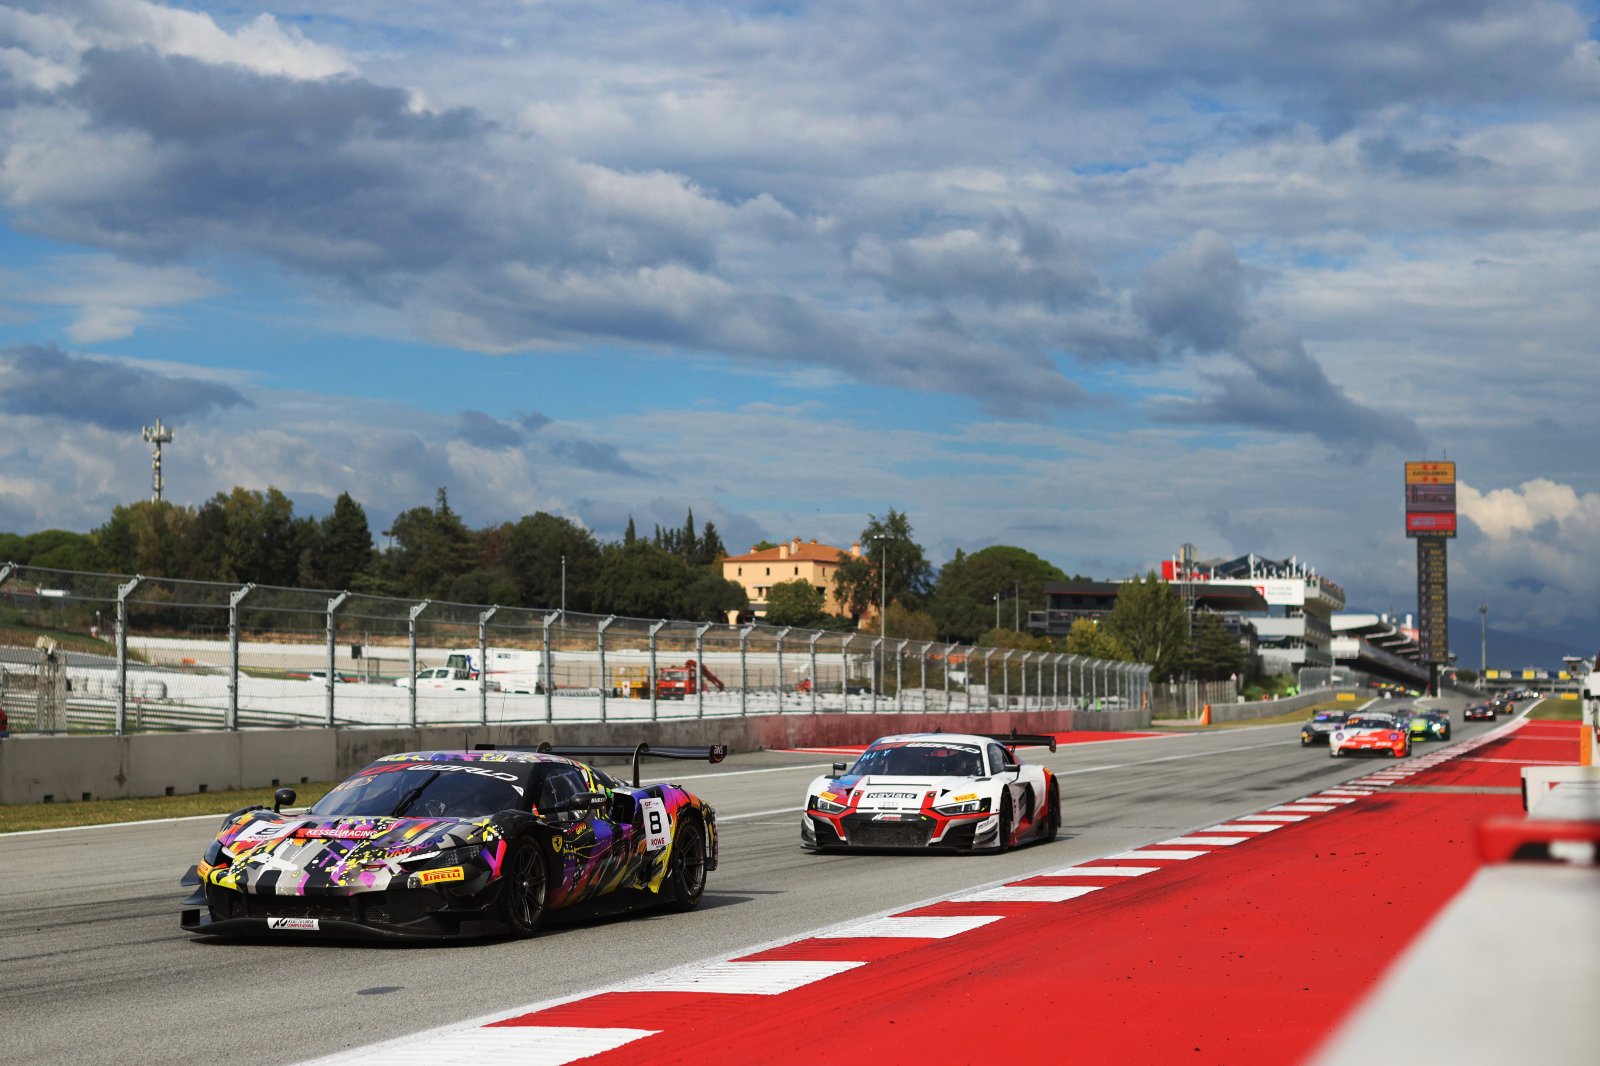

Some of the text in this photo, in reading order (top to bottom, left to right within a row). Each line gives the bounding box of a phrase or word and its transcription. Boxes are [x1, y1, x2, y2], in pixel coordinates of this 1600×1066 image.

[407, 764, 519, 781] WORLD
[649, 811, 662, 834] 8
[341, 829, 378, 837] RACING
[651, 837, 665, 846] ROWE
[422, 868, 461, 882] PIRELLI
